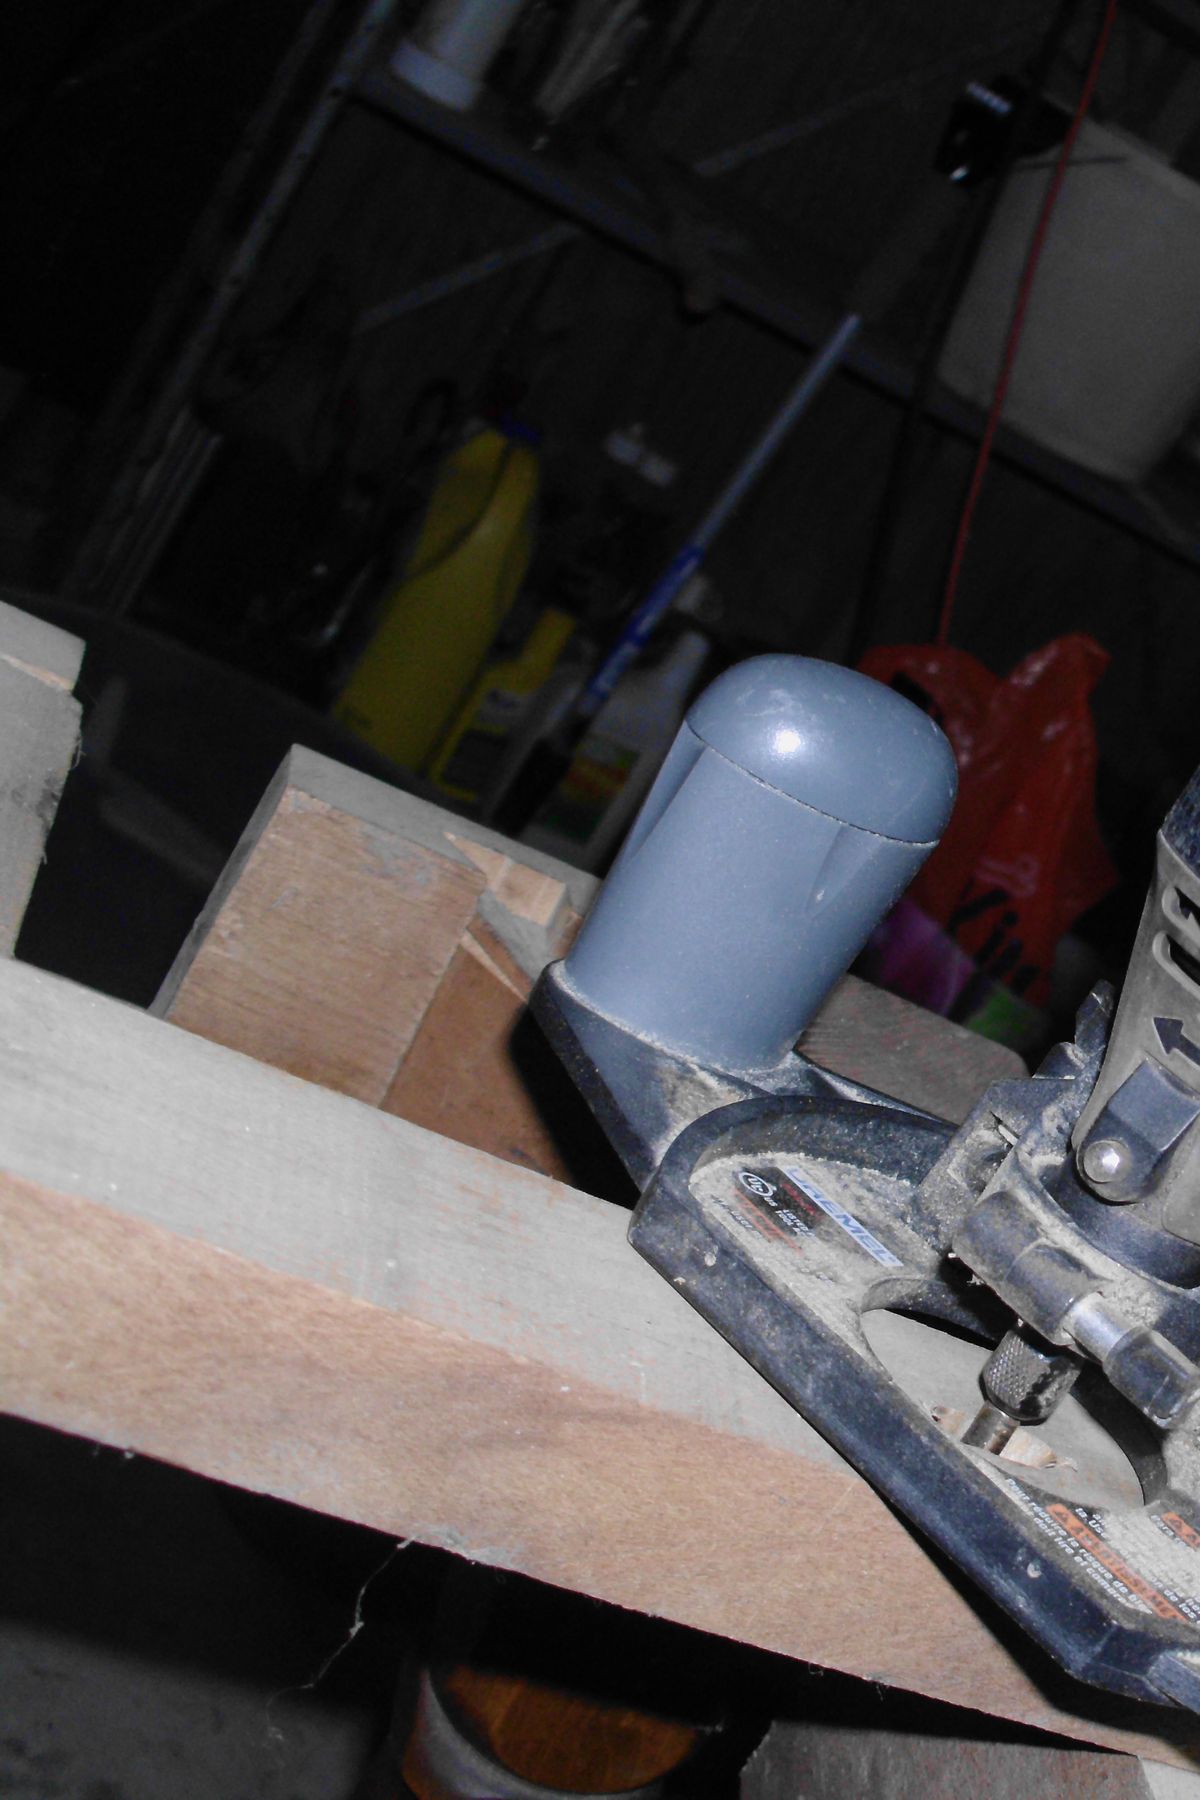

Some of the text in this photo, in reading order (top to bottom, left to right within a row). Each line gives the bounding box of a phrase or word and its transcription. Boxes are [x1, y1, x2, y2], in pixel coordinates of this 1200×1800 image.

[1006, 1478, 1031, 1501] Pour
[1079, 1548, 1114, 1580] risque
[1112, 1580, 1129, 1595] de
[1033, 1516, 1056, 1537] doit
[1054, 1536, 1075, 1555] lire
